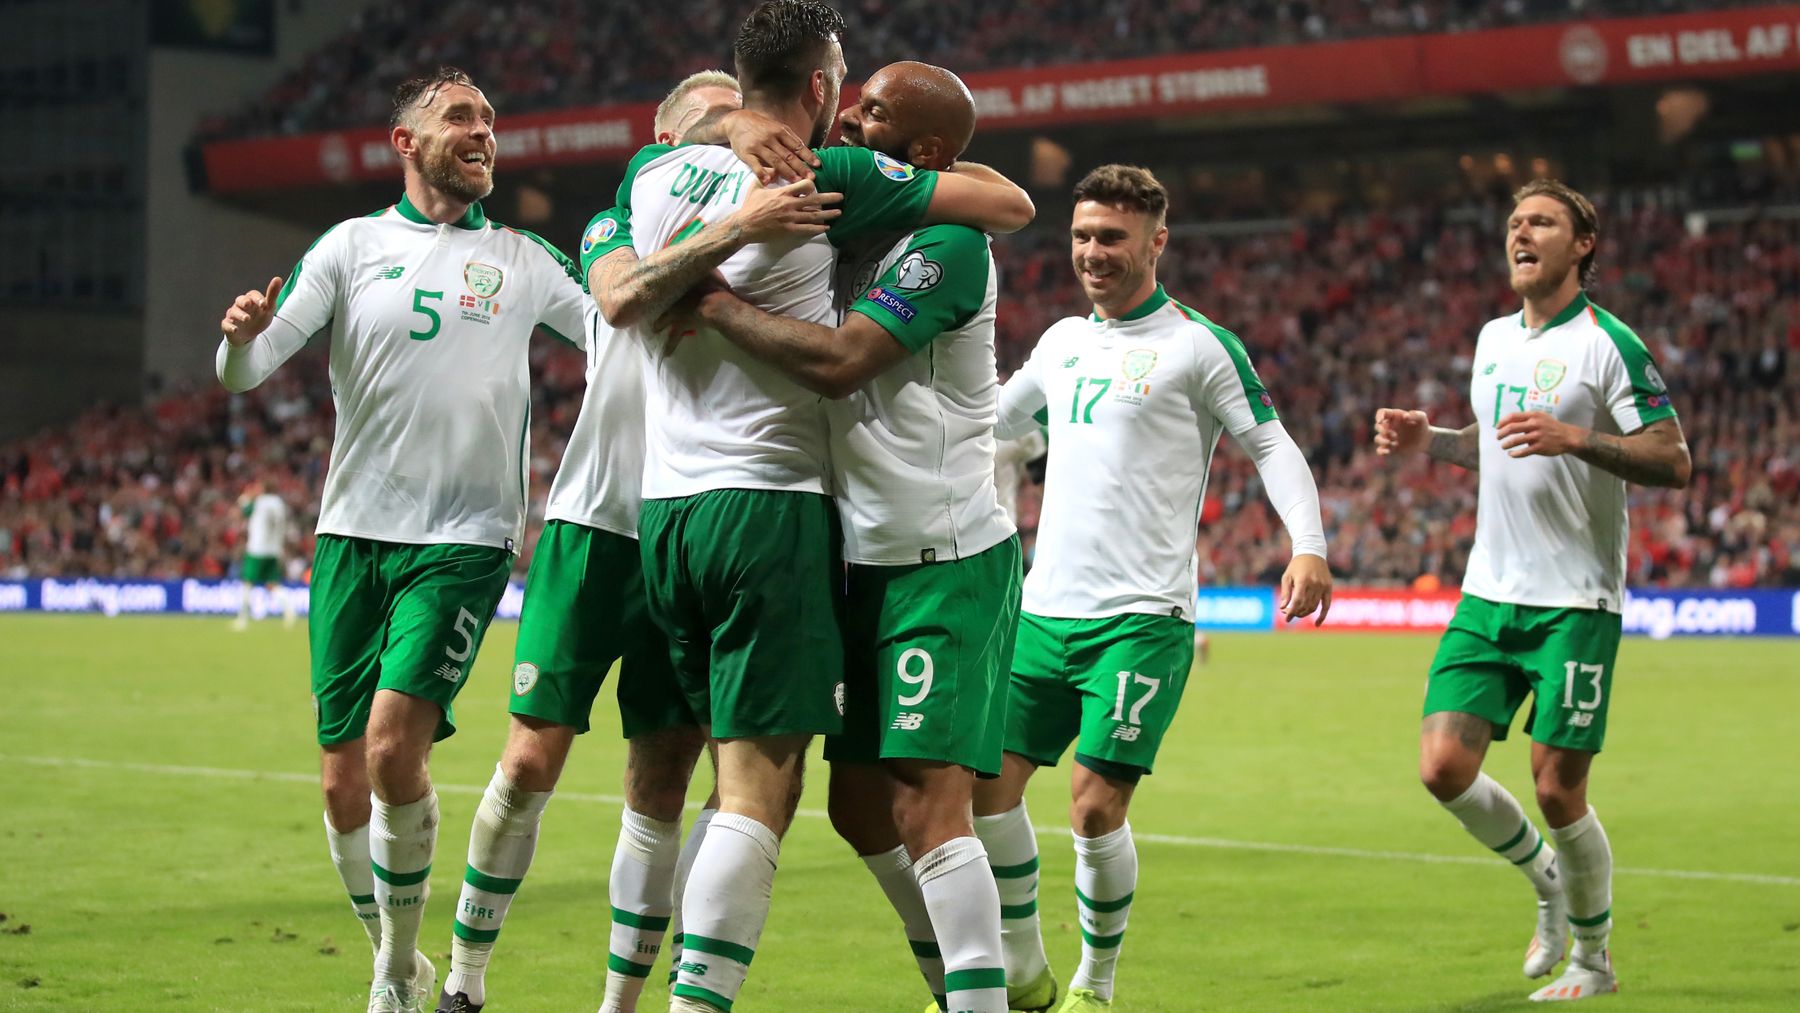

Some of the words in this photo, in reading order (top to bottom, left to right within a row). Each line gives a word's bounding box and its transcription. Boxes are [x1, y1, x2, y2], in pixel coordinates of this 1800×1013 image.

[1627, 34, 1673, 67] EN
[1677, 29, 1740, 64] DEL
[1747, 24, 1790, 57] AF
[409, 288, 444, 341] 5
[878, 292, 915, 319] RESPECT
[1069, 377, 1113, 424] 17
[1492, 384, 1528, 428] 13
[41, 578, 167, 617] Booking.com
[445, 606, 479, 662] 5
[897, 647, 934, 706] 9
[1110, 670, 1161, 725] 17
[1562, 660, 1604, 711] 13
[387, 894, 419, 907] ÉIRE
[464, 898, 495, 919] ÉIRE
